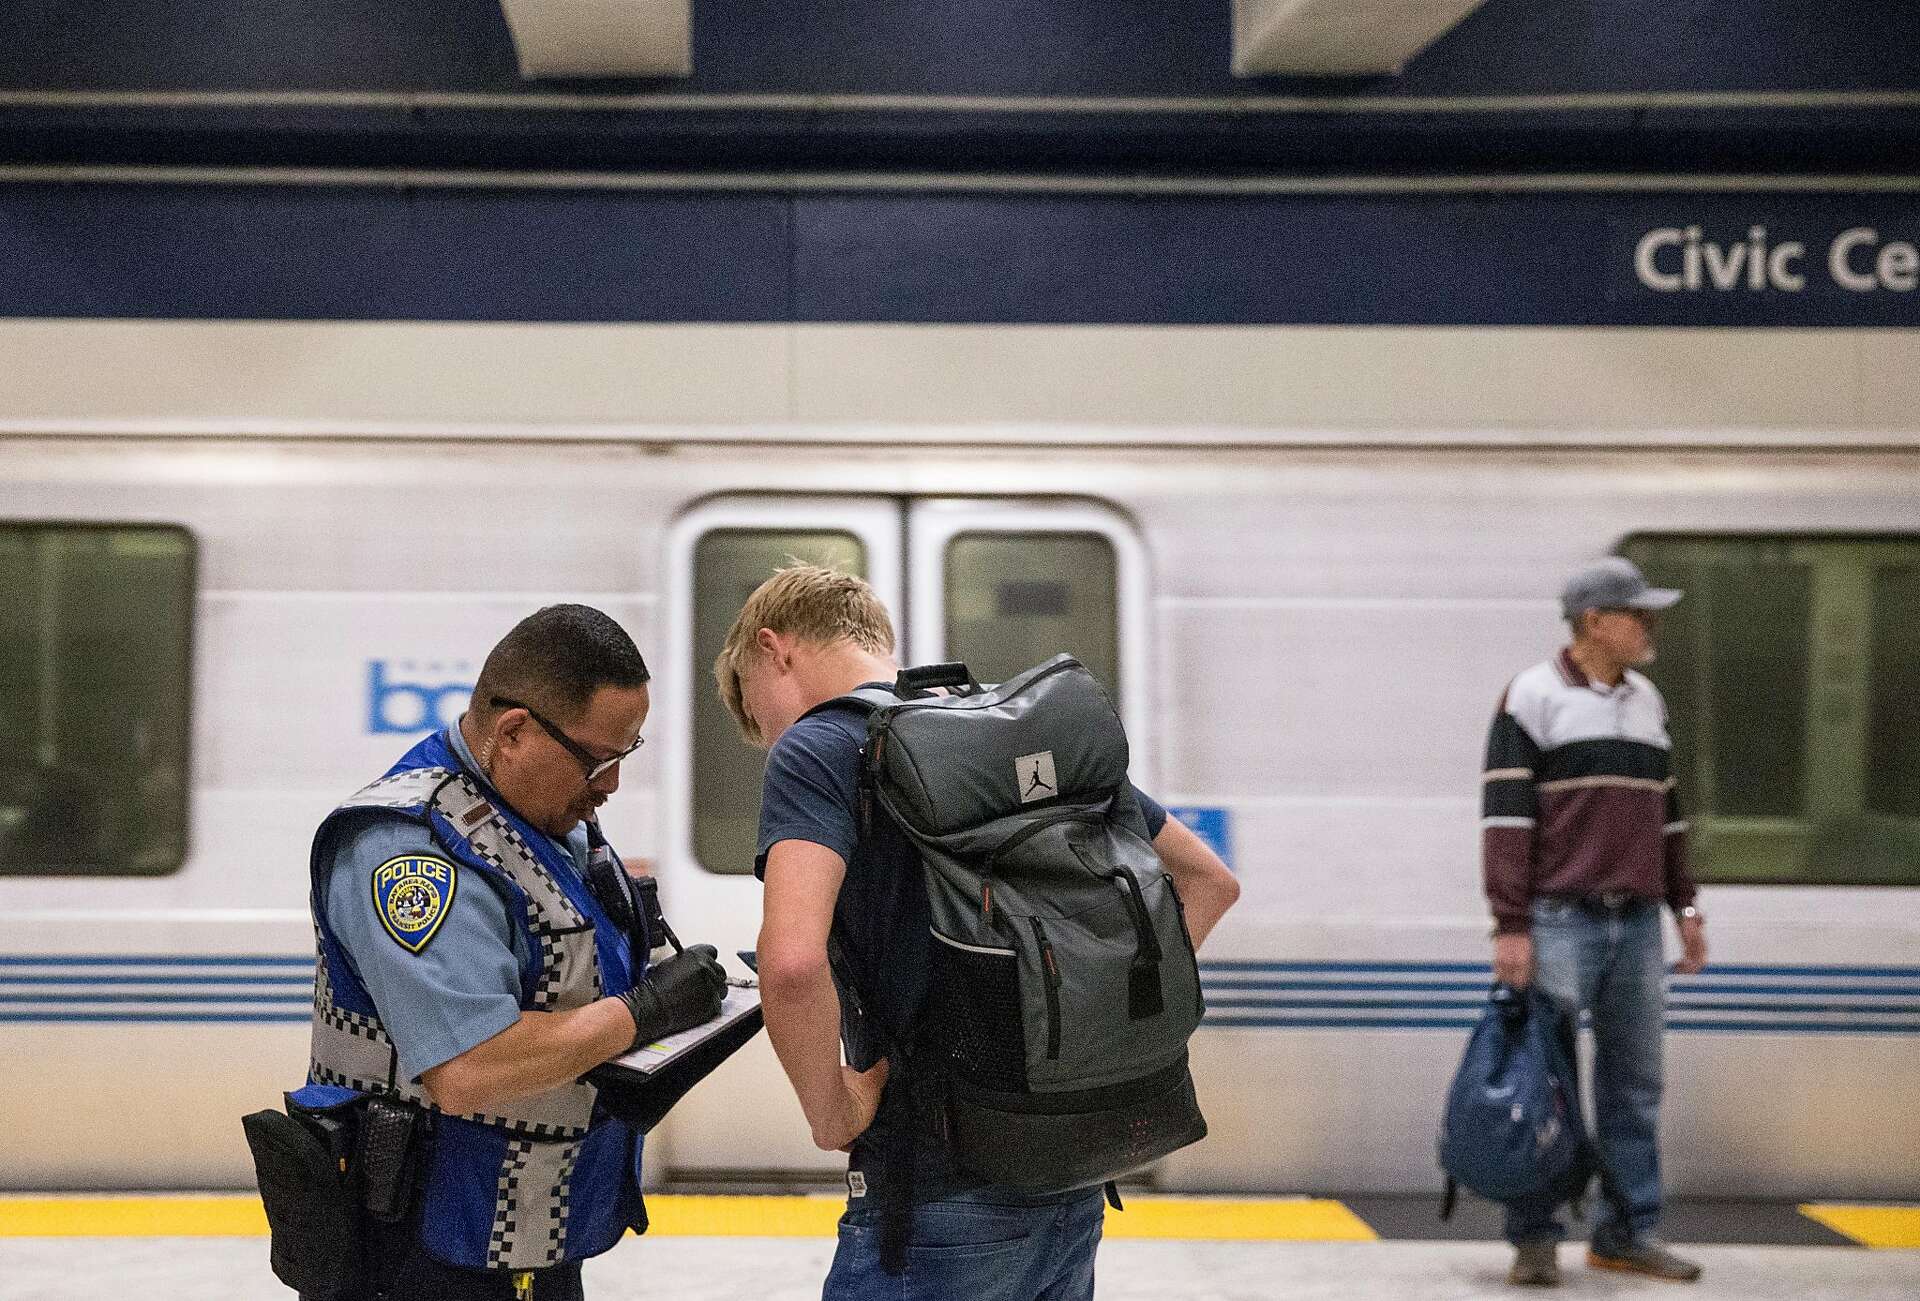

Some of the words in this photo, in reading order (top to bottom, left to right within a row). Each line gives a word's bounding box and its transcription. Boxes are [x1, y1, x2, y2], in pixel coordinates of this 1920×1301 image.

[1635, 225, 1805, 292] Civic
[1828, 227, 1920, 292] Ce
[381, 861, 447, 889] POLICE
[389, 889, 398, 904] BAY
[398, 879, 419, 889] AREA
[417, 905, 438, 928] POLICE
